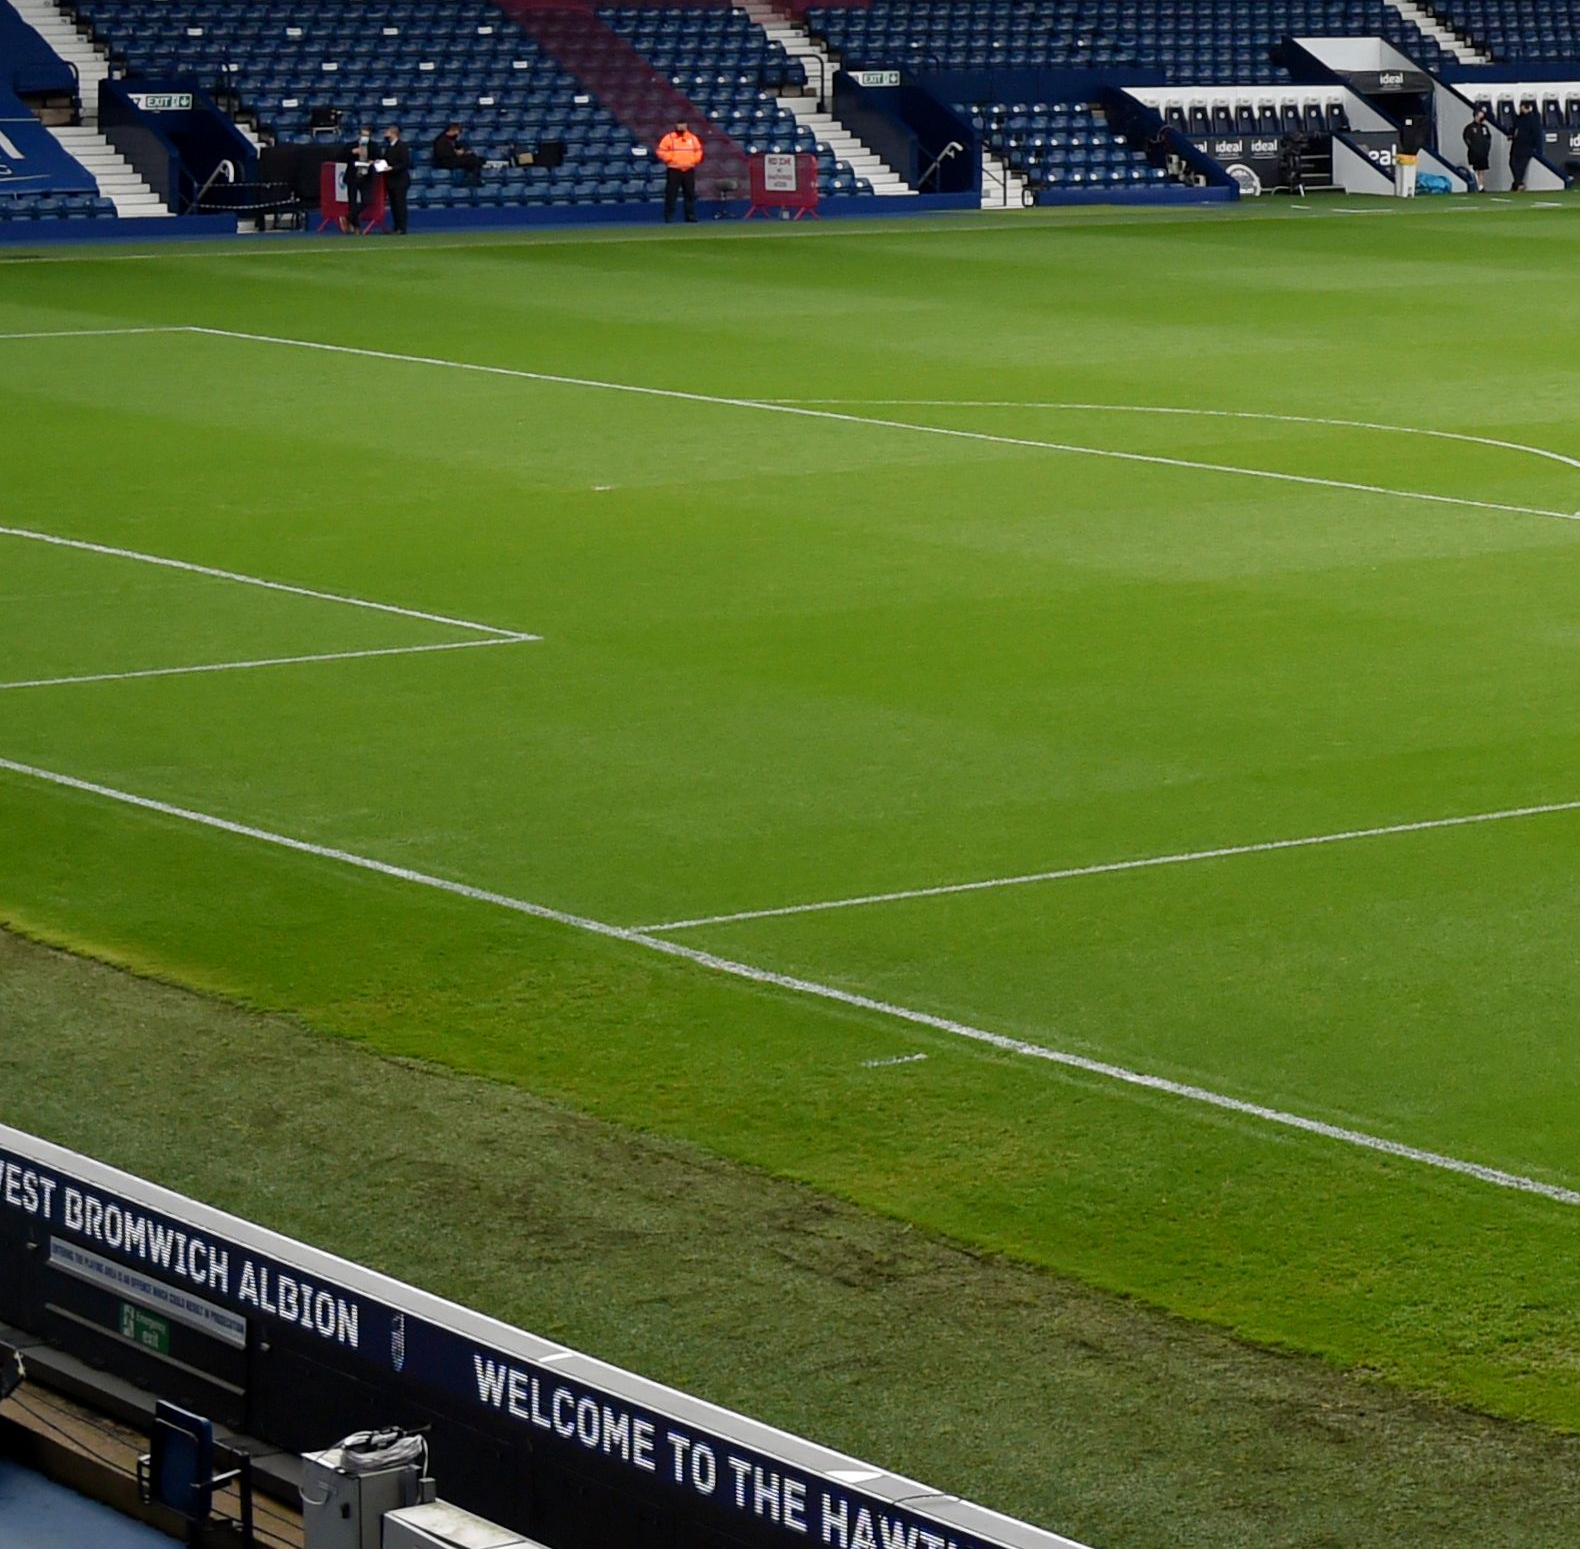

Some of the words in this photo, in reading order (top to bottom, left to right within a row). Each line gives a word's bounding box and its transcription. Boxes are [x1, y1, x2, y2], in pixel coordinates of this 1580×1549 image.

[1379, 72, 1404, 85] ideal
[148, 96, 171, 107] EXIT
[1215, 139, 1243, 153] ideal
[1251, 138, 1278, 152] ideal
[64, 1187, 229, 1294] BROMWICH
[238, 1259, 359, 1349] ALBION
[473, 1353, 656, 1474] WELCOME
[667, 1429, 717, 1497] TO
[727, 1456, 808, 1533] THE
[821, 1491, 965, 1549] HAW
